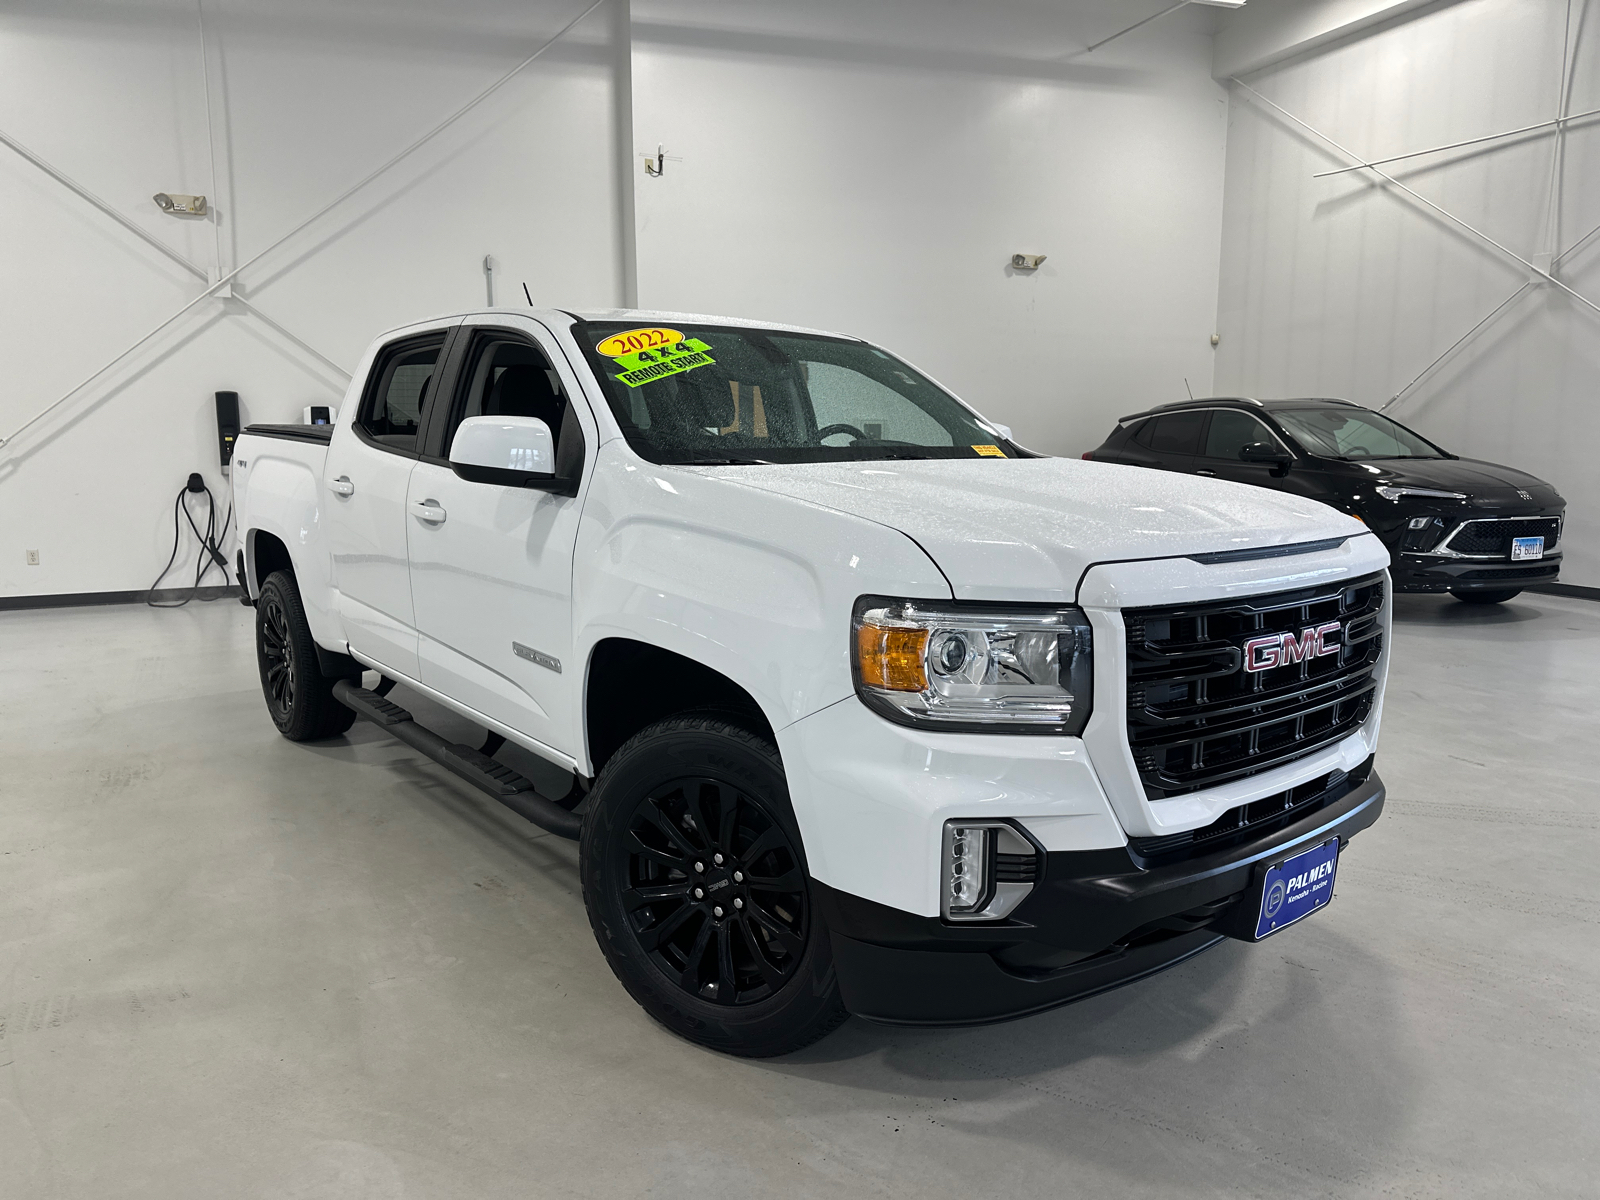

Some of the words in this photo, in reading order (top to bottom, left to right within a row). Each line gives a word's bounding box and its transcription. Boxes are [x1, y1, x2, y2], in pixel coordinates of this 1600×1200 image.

[613, 330, 670, 354] 2022
[622, 361, 675, 384] REMOTE
[670, 352, 708, 369] START
[1243, 621, 1340, 673] GMC
[1286, 858, 1334, 895] PALMEN
[1287, 888, 1310, 904] Kenosha
[1312, 879, 1328, 893] Racine
